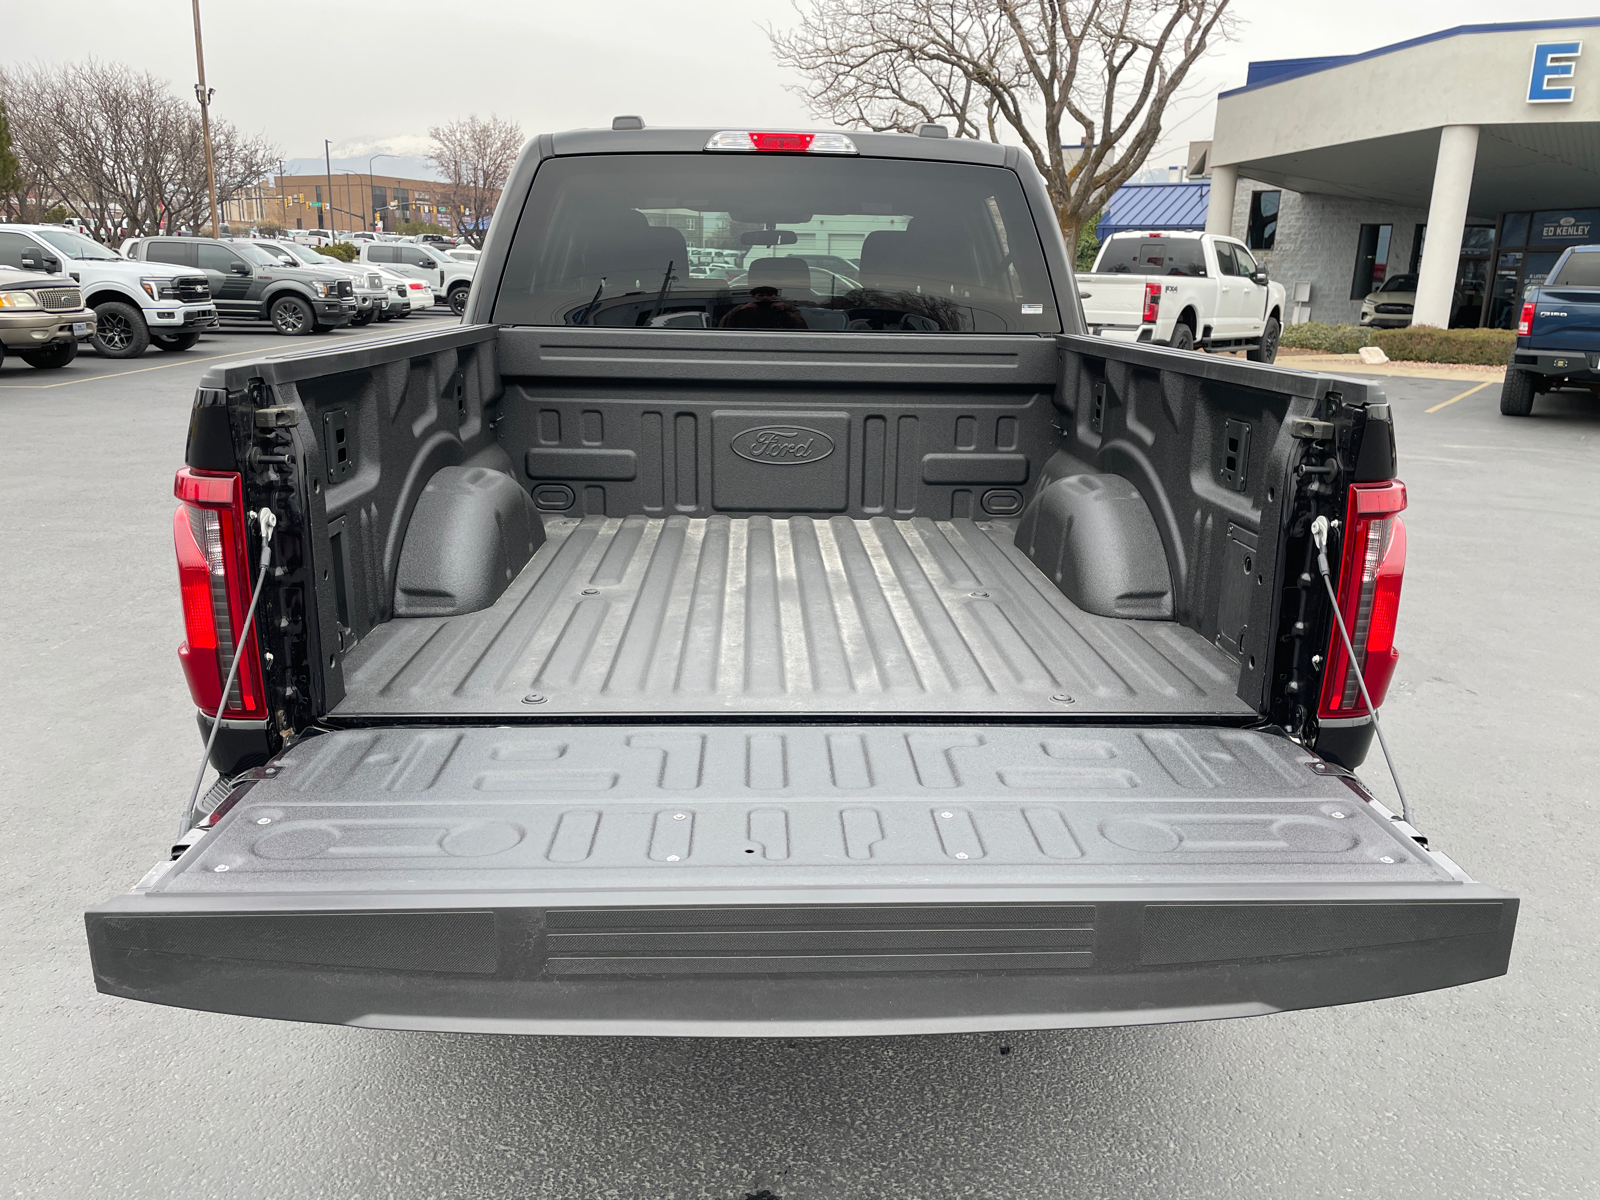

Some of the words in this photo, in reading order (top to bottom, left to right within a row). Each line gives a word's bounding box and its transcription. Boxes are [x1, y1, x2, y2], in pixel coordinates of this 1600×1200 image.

[1526, 40, 1583, 103] E
[1543, 226, 1555, 236] ED
[1556, 226, 1590, 235] KENLEY
[750, 430, 814, 458] Ford
